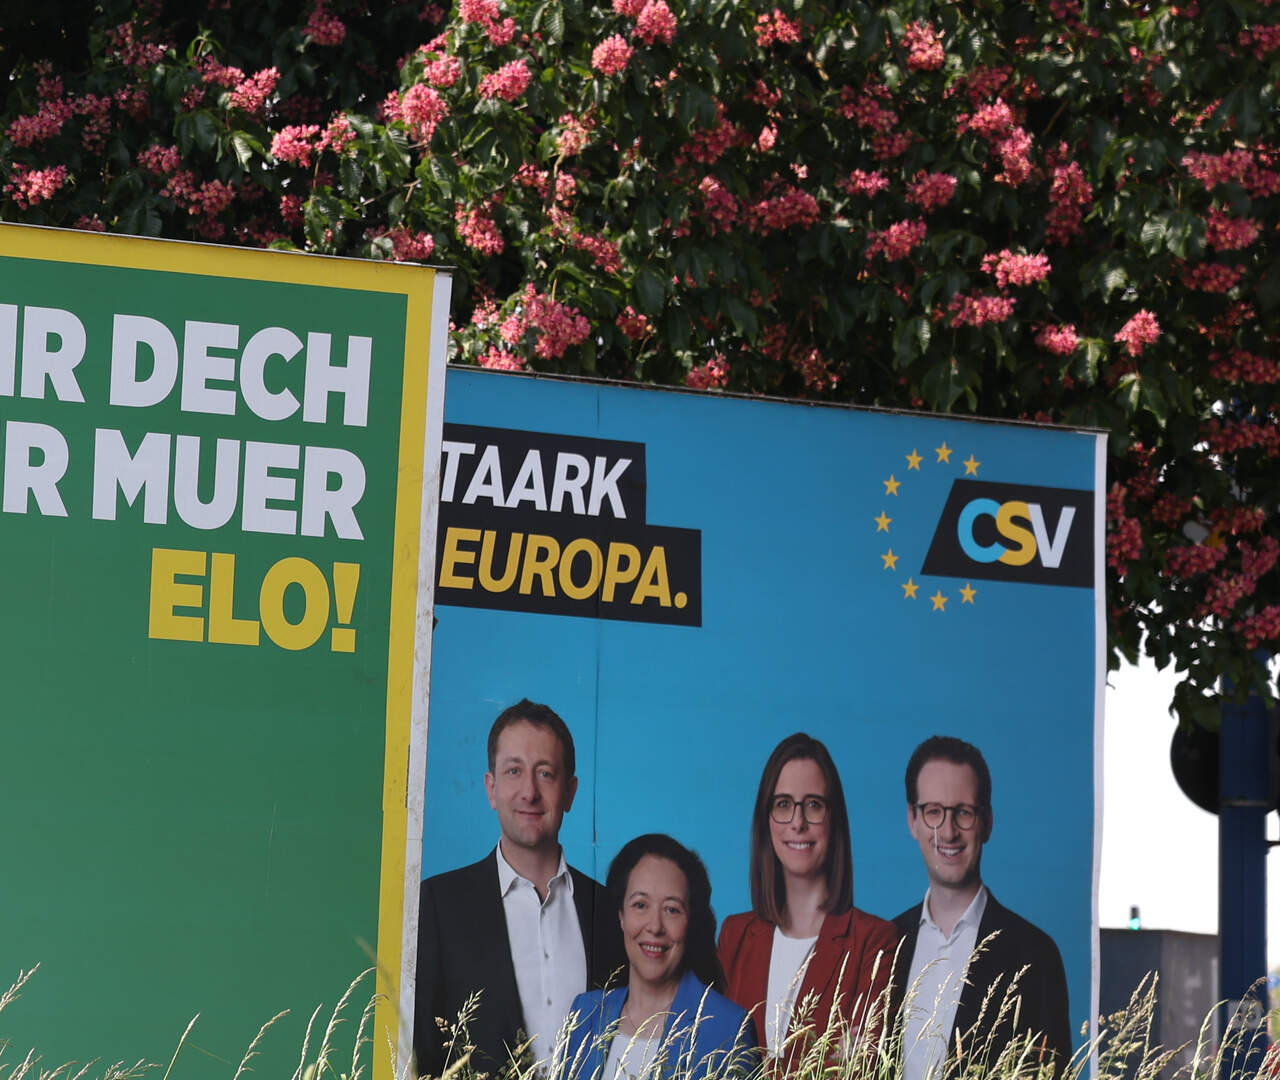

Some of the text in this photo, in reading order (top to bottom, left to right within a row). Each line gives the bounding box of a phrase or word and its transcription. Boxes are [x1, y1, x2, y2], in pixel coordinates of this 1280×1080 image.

[109, 313, 373, 427] DECH
[92, 428, 366, 541] MUER
[440, 441, 632, 519] TAARK
[438, 527, 689, 609] EUROPA.
[957, 498, 1076, 569] CSV
[148, 548, 361, 653] ELO!
